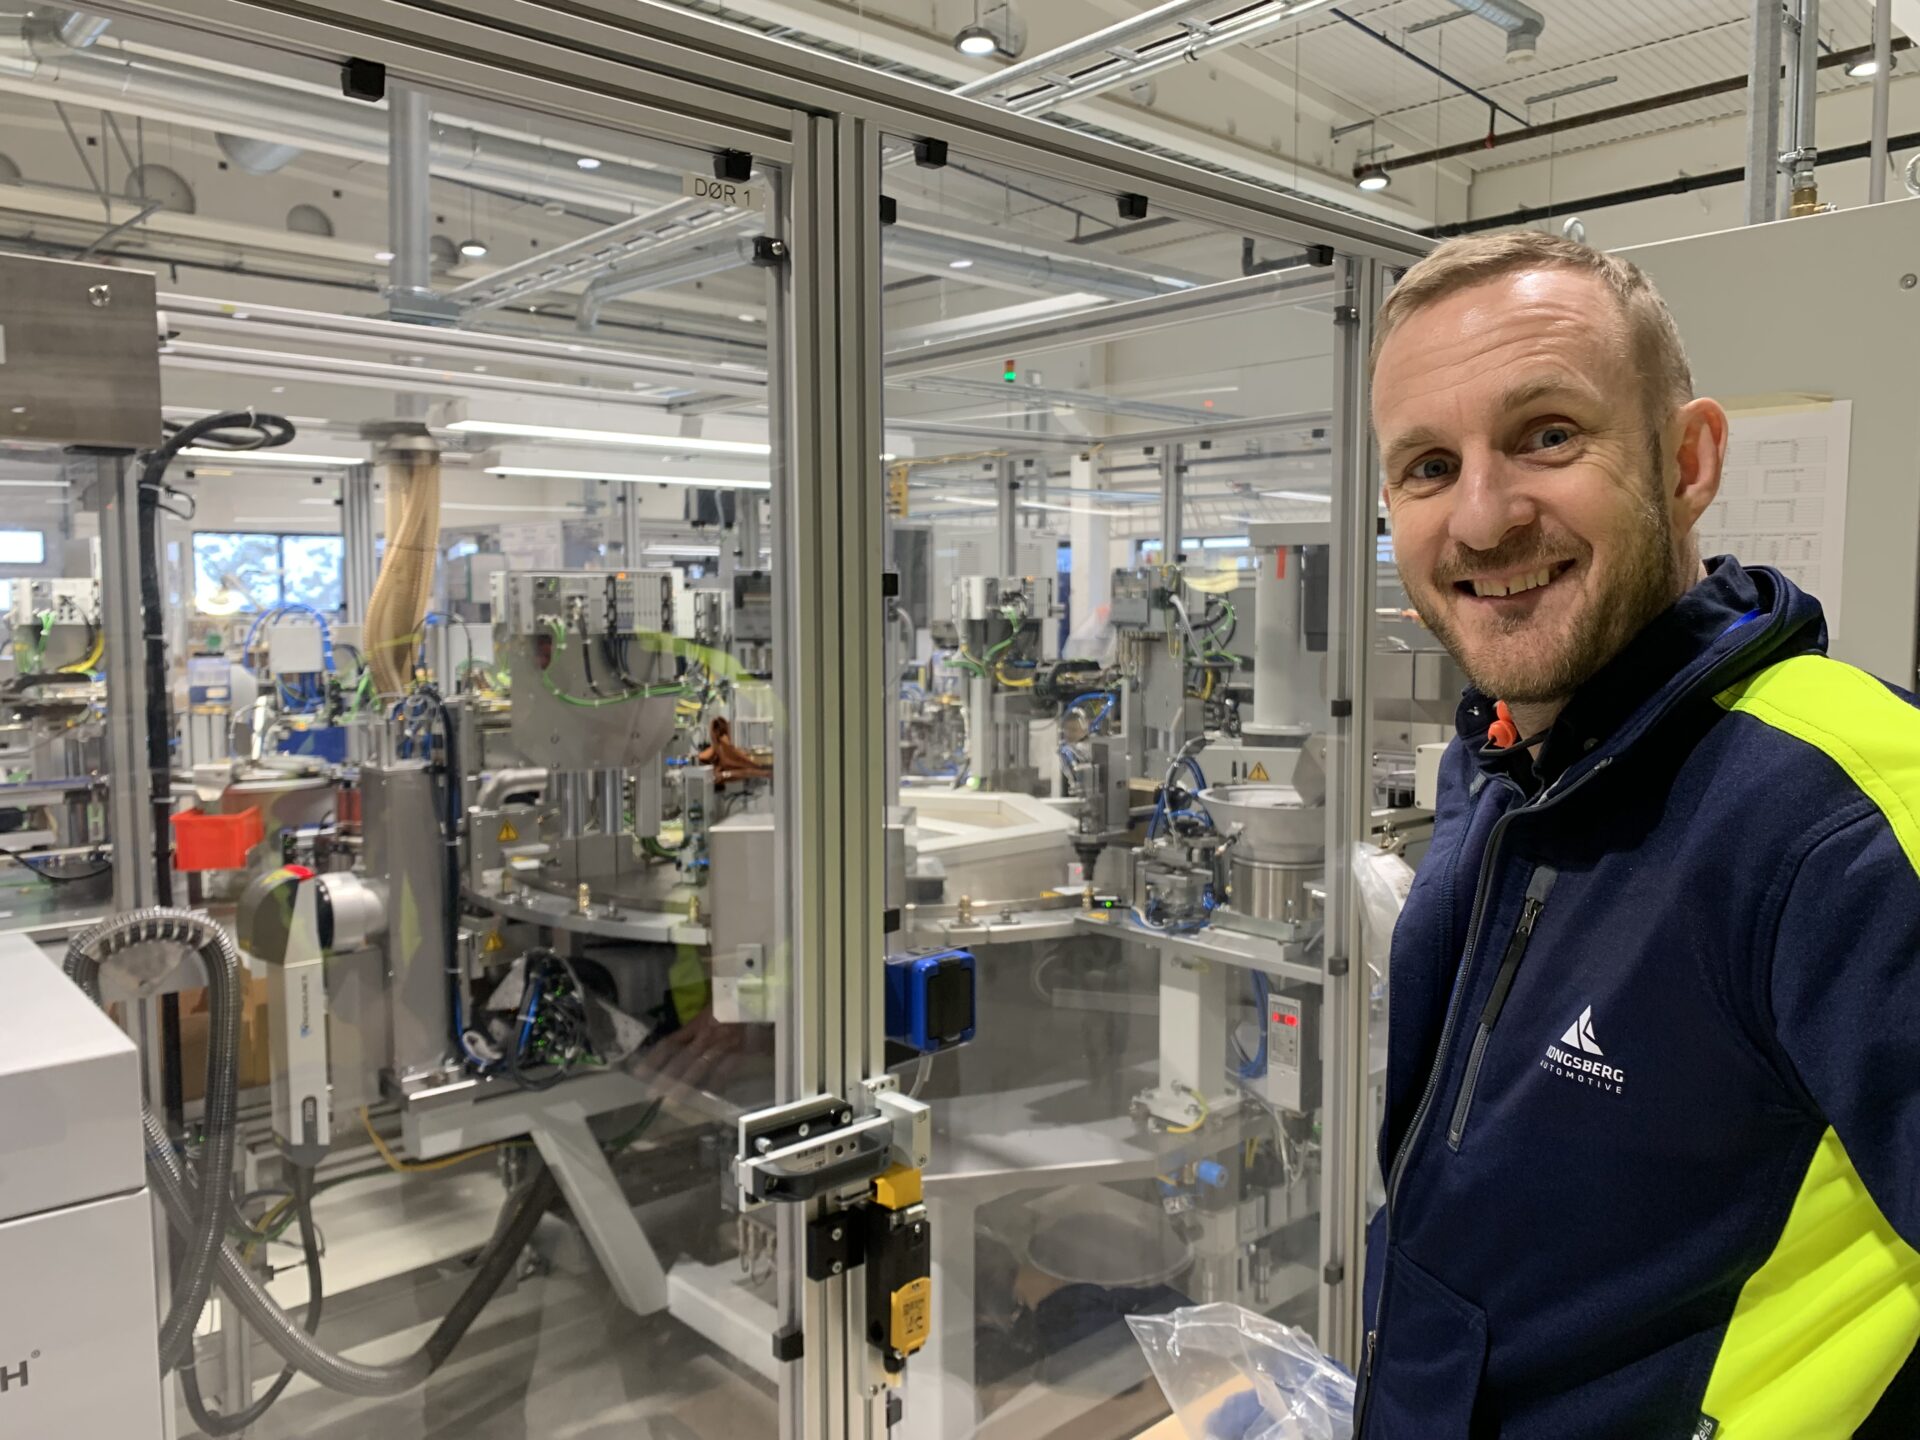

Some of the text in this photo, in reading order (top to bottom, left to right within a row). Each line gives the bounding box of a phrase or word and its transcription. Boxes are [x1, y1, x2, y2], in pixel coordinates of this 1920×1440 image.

[695, 178, 751, 206] DØR 1
[1540, 1060, 1622, 1095] AUTOMOTIVE
